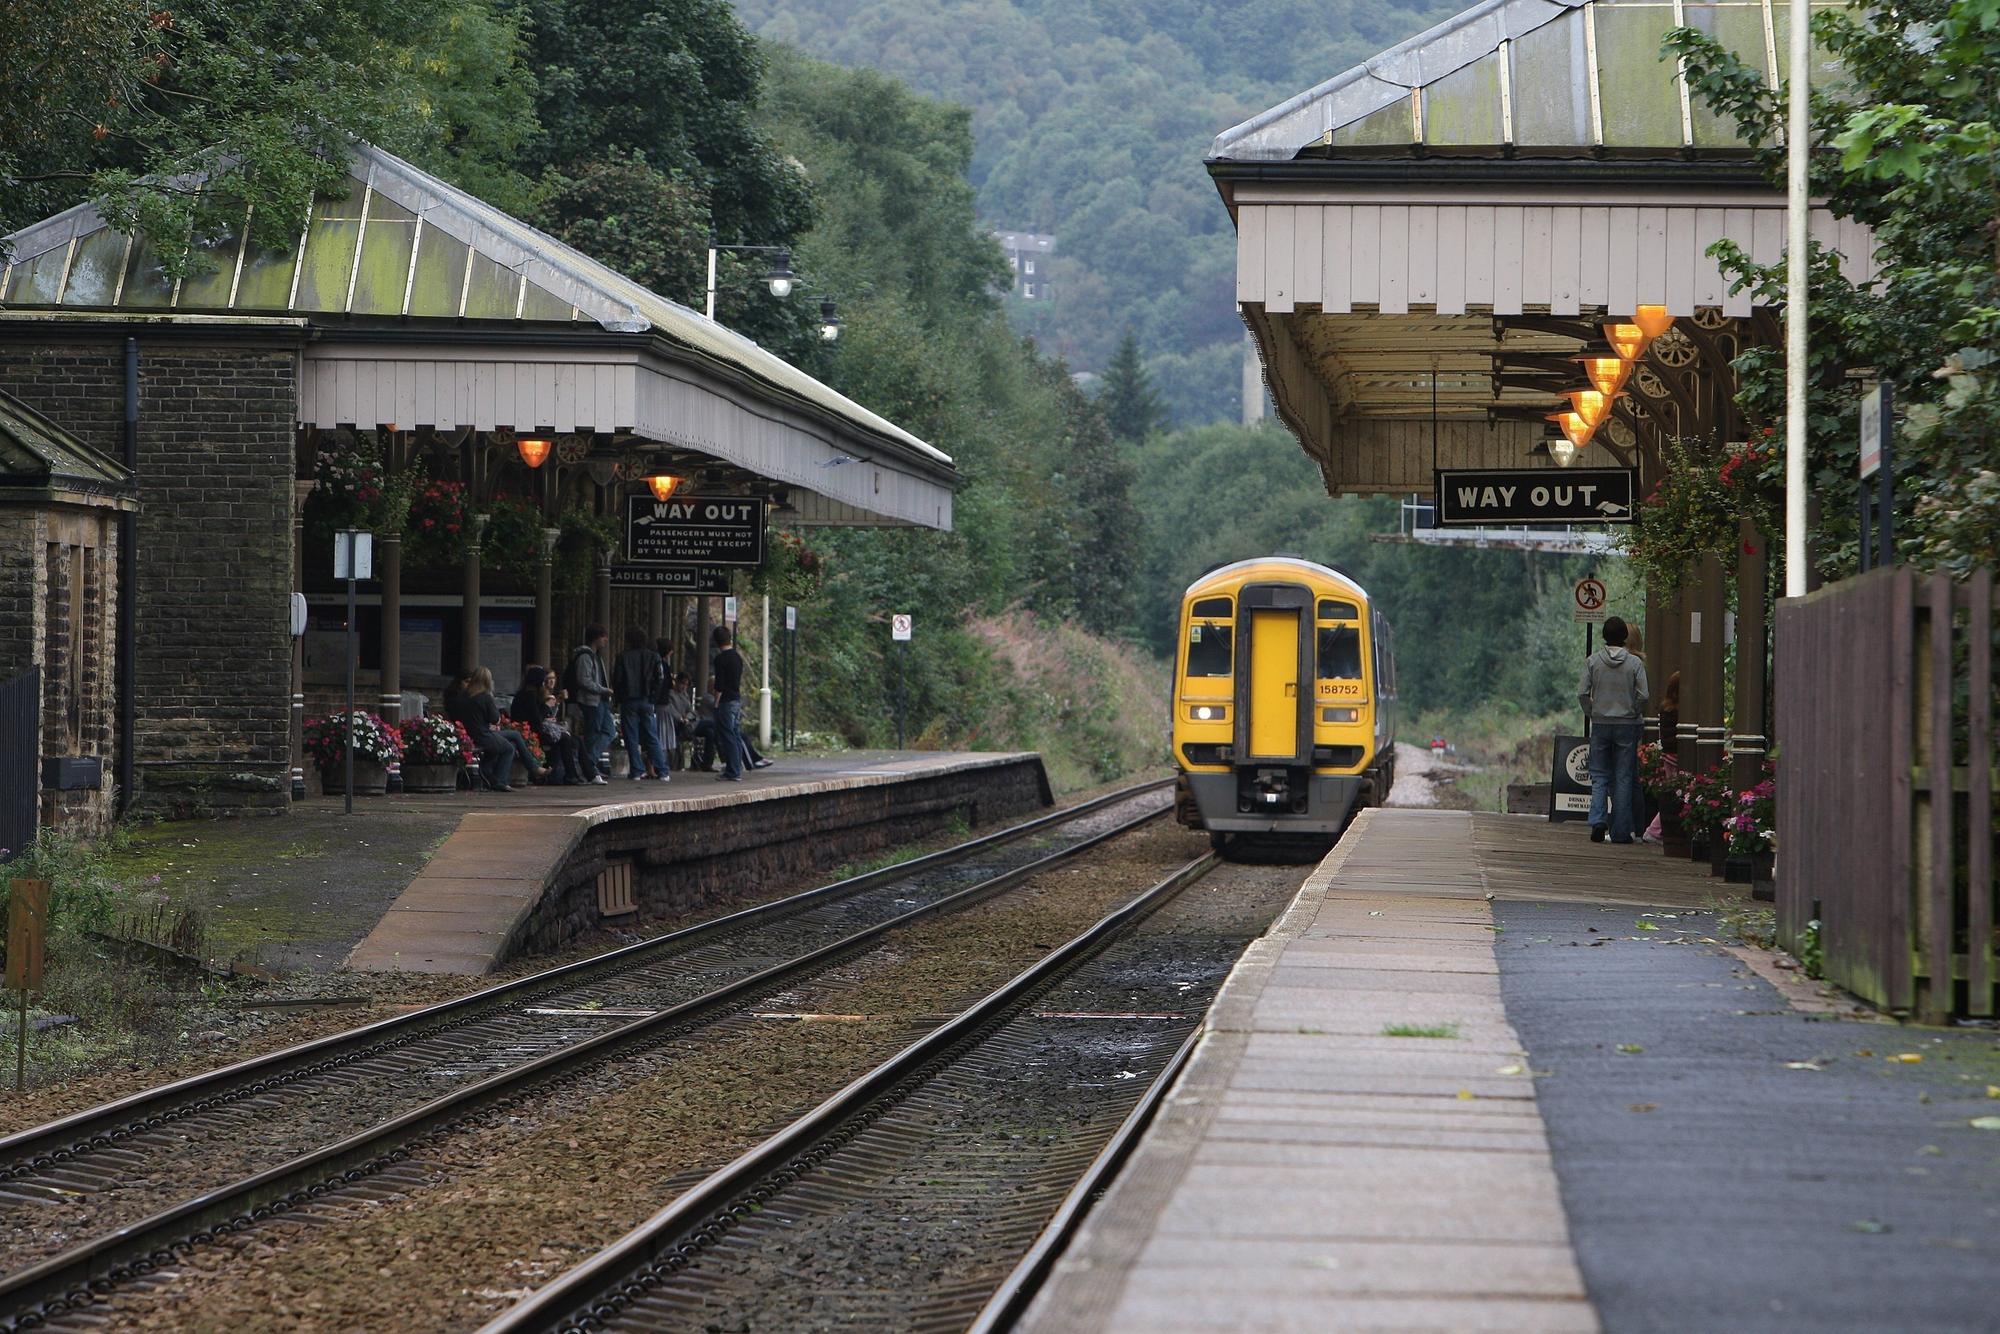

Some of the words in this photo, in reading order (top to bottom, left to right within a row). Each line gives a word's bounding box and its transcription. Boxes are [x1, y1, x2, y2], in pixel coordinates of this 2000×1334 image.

[1457, 485, 1517, 508] WAY
[1530, 485, 1597, 507] OUT
[653, 504, 695, 519] WAY
[705, 505, 751, 520] OUT
[650, 529, 705, 537] PASSENGERS
[637, 538, 667, 546] CROSS
[637, 547, 649, 555] BY
[676, 548, 712, 556] SUBWAY
[656, 573, 691, 582] ROOM
[1320, 685, 1358, 694] 158752
